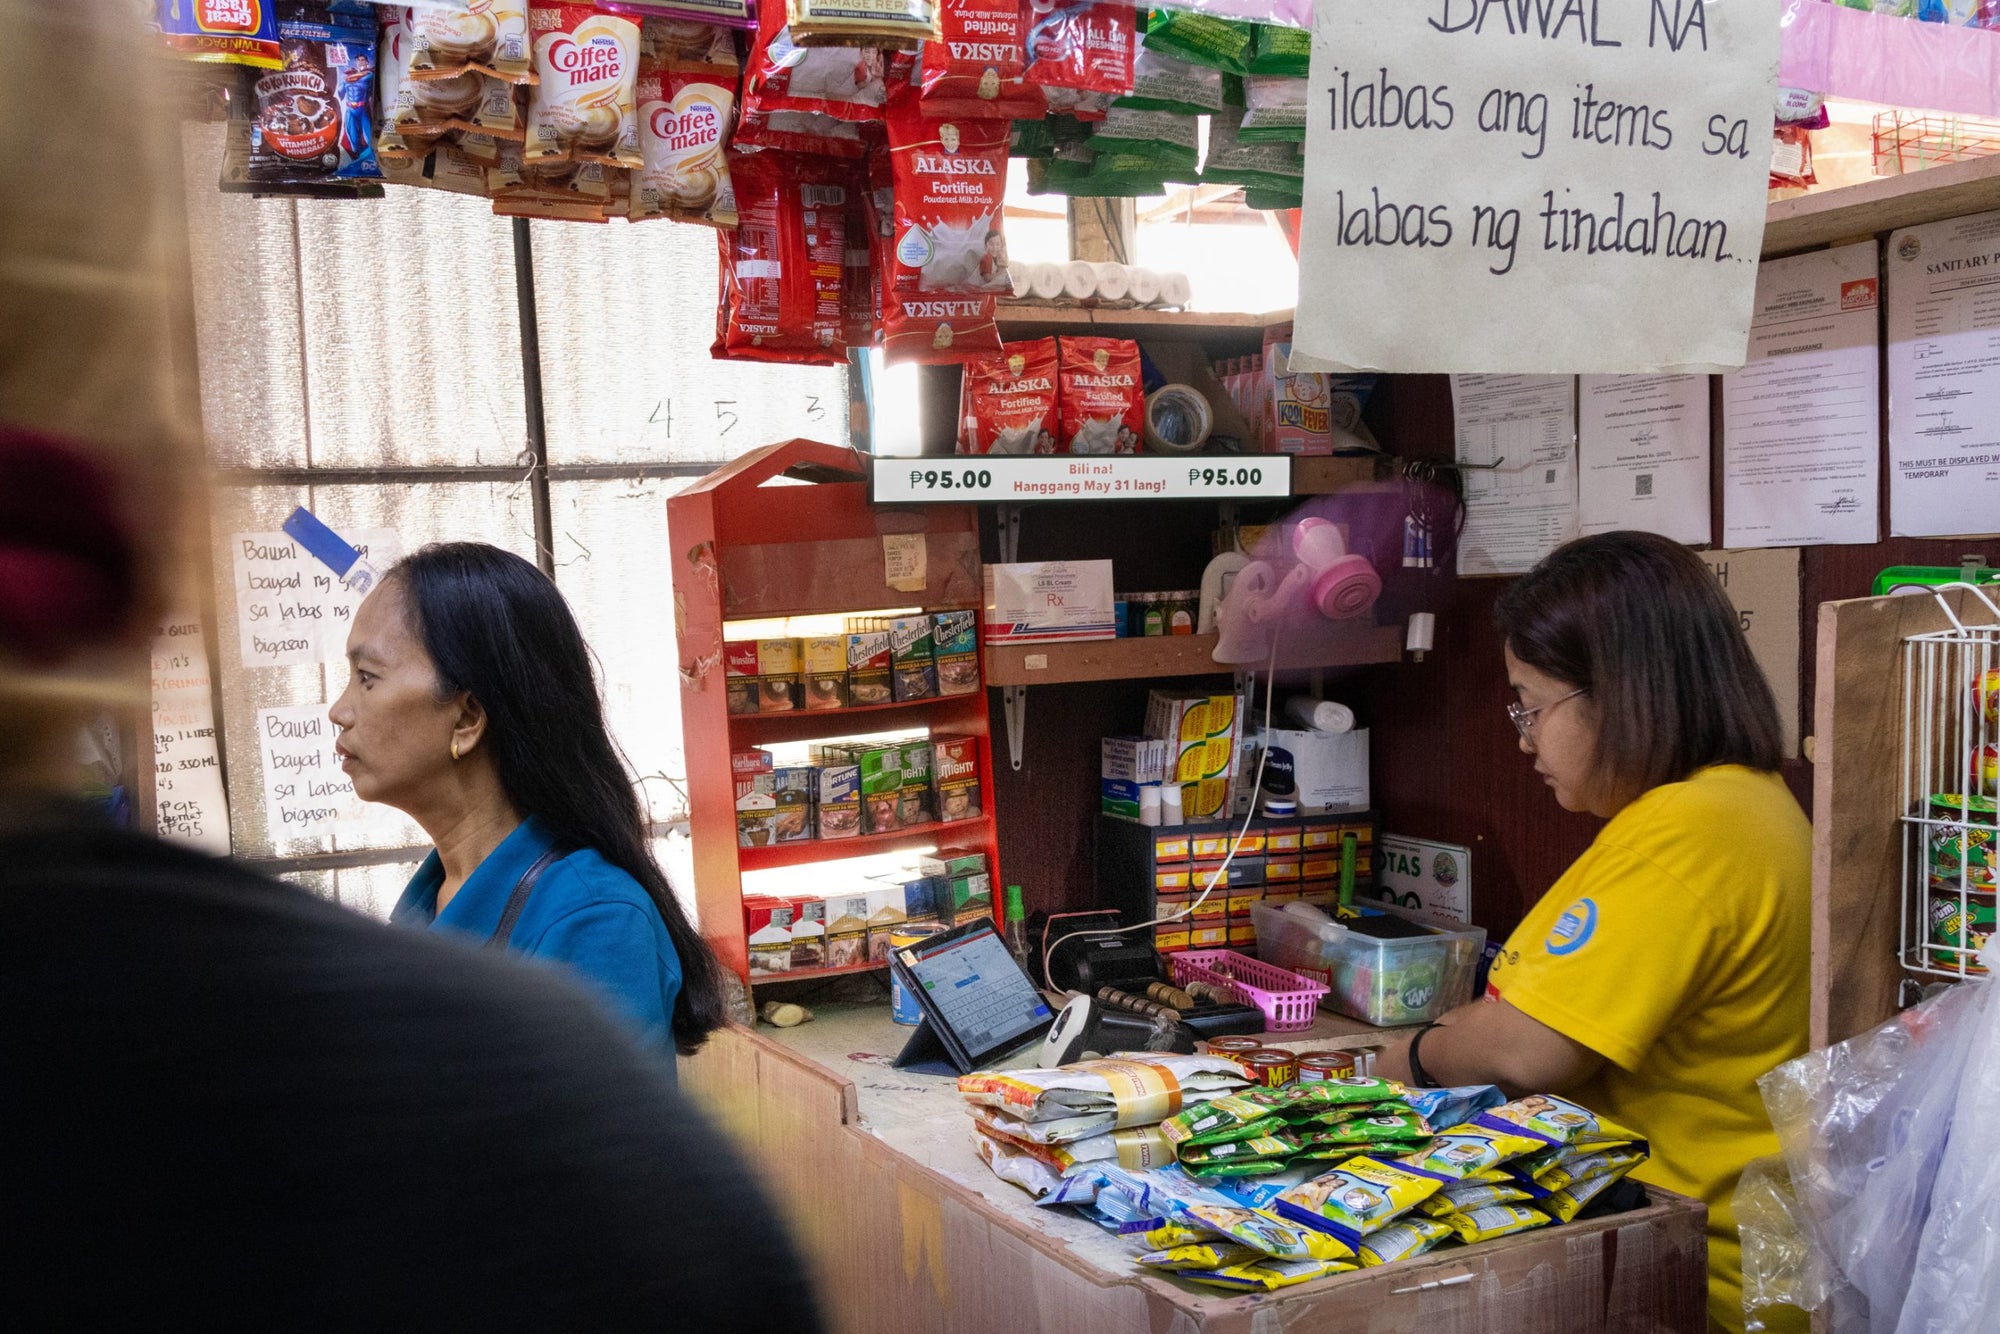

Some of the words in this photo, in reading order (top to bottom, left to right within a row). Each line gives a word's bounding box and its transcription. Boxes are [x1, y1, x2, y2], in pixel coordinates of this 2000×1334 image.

[206, 10, 252, 25] Great
[531, 9, 561, 19] NEW
[531, 17, 562, 29] RECIPE
[964, 20, 1017, 36] Fortified
[1088, 29, 1106, 40] ALL
[1649, 0, 1707, 51] NA
[196, 37, 227, 49] PACK
[231, 40, 262, 52] TWIN
[549, 38, 617, 72] Coffee
[948, 42, 1020, 63] LASKA
[569, 63, 621, 86] mate
[1327, 66, 1454, 131] ilabas
[1478, 88, 1549, 159] ang
[1571, 83, 1673, 150] items
[1702, 114, 1749, 159] sa
[650, 107, 715, 139] Coffee
[279, 138, 317, 149] VITAMINS
[671, 129, 717, 151] mate
[915, 156, 996, 176] ALASKA
[932, 181, 983, 197] Fortified
[923, 196, 958, 204] Powdered
[959, 195, 974, 204] Milk
[975, 195, 994, 204] Drink
[1336, 186, 1453, 247] labas
[1472, 205, 1521, 275] ng
[1927, 254, 1991, 275] SANITARY
[902, 300, 983, 319] ALASKA
[739, 323, 777, 334] ALASKA
[1768, 348, 1792, 357] BUSINESS
[1792, 343, 1823, 353] CLEARANCE
[988, 378, 1052, 396] ALASKA
[1073, 375, 1135, 388] ALASKA
[1001, 396, 1042, 408] Fortified
[1086, 390, 1124, 402] Fortified
[649, 398, 674, 439] 4
[714, 401, 738, 437] 5
[806, 396, 826, 422] 3
[1303, 408, 1328, 431] FEVER
[1899, 460, 1914, 468] THIS
[1916, 459, 1936, 467] MUST
[1938, 457, 1947, 466] BE
[1949, 455, 1989, 465] DISPLAYED
[909, 470, 992, 489] ₱95.00
[1069, 463, 1091, 475] Bili
[1093, 463, 1114, 475] na!
[1188, 467, 1263, 486] ₱95.00
[1905, 470, 1949, 480] TEMPORARY
[1014, 480, 1081, 495] Hanggang
[1084, 480, 1111, 494] May
[1114, 479, 1131, 490] 31
[1134, 479, 1167, 494] lang!
[243, 540, 297, 561] Bawal
[248, 571, 301, 596] bayad
[313, 575, 331, 593] ng
[1047, 593, 1064, 606] Rx
[249, 604, 269, 621] sa
[279, 602, 322, 621] labas
[333, 605, 350, 621] ng
[890, 620, 932, 651] Chesterfield
[933, 611, 976, 646] Chesterfield
[763, 641, 793, 650] CAMEL
[811, 640, 841, 649] CAMEL
[848, 636, 890, 667] Chesterfield
[730, 655, 756, 666] Winston
[266, 715, 322, 739] Bawal
[270, 749, 321, 775] bayad
[940, 761, 974, 779] MIGHTY
[823, 769, 858, 788] FORTUNE
[274, 784, 295, 801] sa
